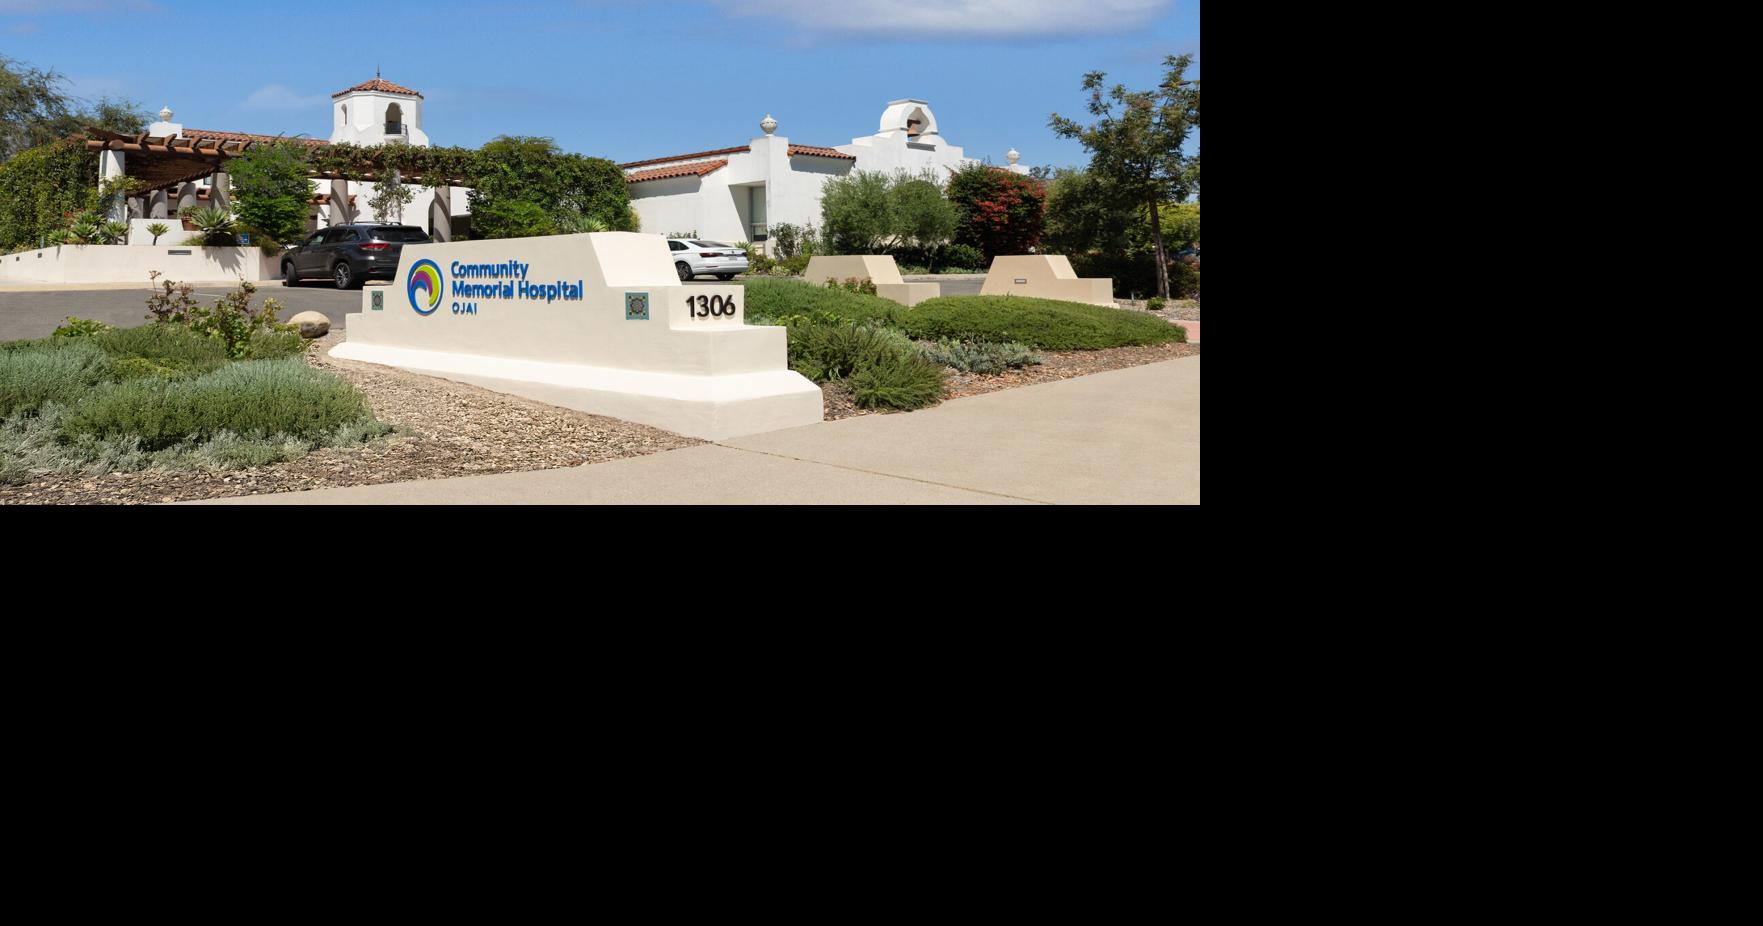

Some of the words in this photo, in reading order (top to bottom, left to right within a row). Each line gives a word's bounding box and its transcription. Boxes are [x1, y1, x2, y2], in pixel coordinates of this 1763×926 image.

[451, 260, 529, 281] Community
[452, 281, 514, 300] Memorial
[518, 280, 583, 304] Hospital
[452, 302, 478, 315] OJAI
[686, 295, 736, 318] 1306
